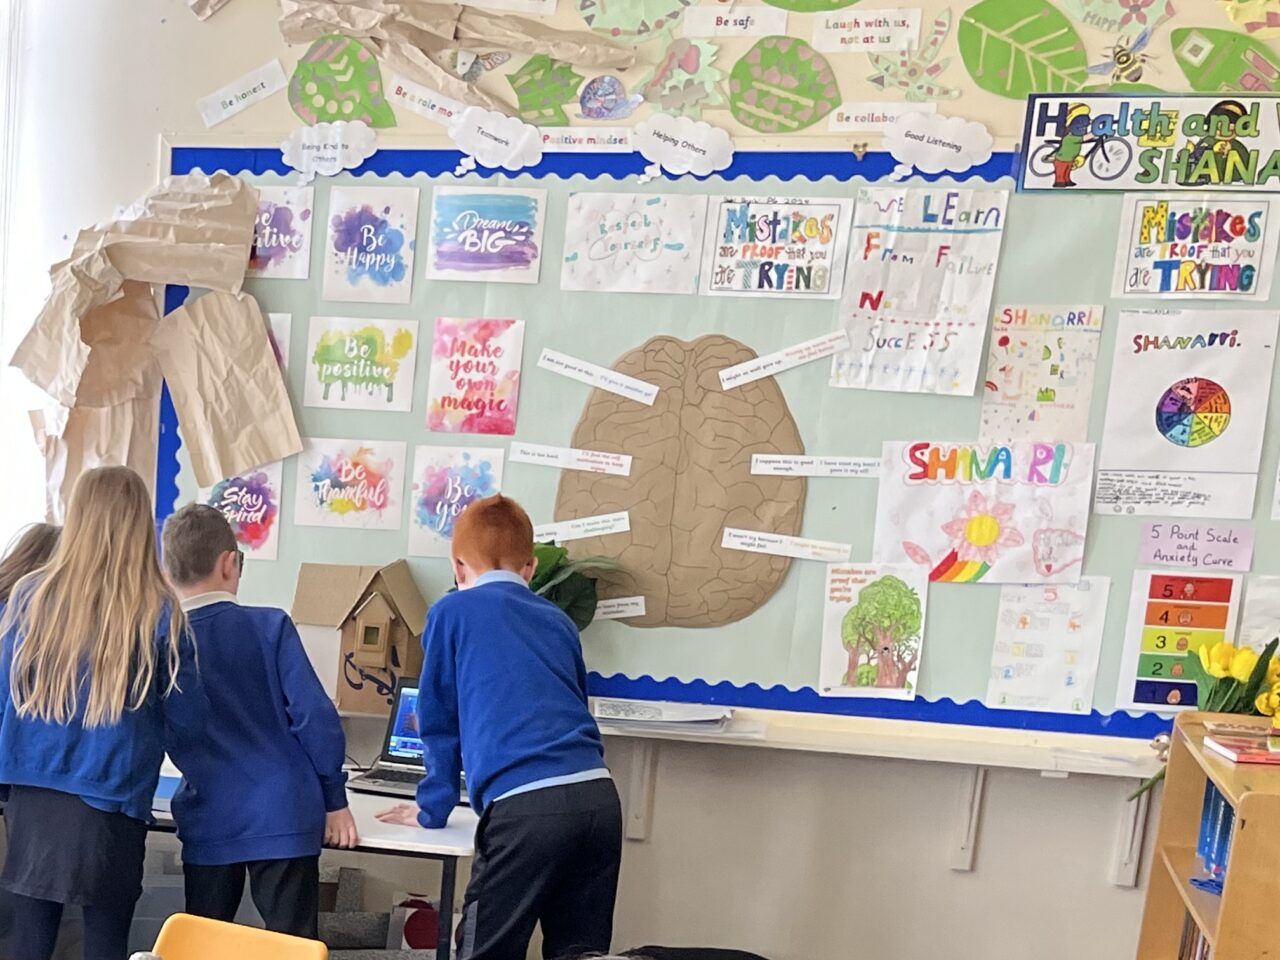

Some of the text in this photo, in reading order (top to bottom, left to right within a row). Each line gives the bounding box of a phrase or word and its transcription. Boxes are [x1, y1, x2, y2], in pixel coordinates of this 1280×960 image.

[715, 15, 755, 29] Be safe
[825, 18, 910, 32] Laugh with us,
[840, 35, 891, 45] not at us
[221, 81, 267, 110] Be honest
[395, 85, 407, 98] Be
[418, 97, 437, 110] role
[836, 112, 851, 123] Be
[1036, 101, 1173, 138] Health
[1182, 102, 1260, 138] and
[476, 126, 511, 147] Teamwork
[542, 134, 629, 145] Positive mindset
[652, 129, 708, 156] Helping Others
[904, 130, 962, 152] Good Listening
[455, 210, 514, 230] Dream
[723, 202, 834, 245] Mistakes
[1139, 200, 1263, 245] Mistakes
[360, 224, 385, 251] Be
[458, 231, 517, 253] BIG
[347, 247, 396, 272] Happy
[742, 243, 785, 259] PROOF
[1134, 243, 1256, 263] are PROOF that you
[736, 260, 829, 290] TRYING
[1129, 258, 1256, 291] are TRYING
[343, 336, 371, 358] Be
[449, 337, 504, 358] Make
[321, 359, 392, 380] positive
[449, 359, 499, 380] your
[456, 378, 497, 391] own
[440, 394, 508, 418] magic
[340, 459, 365, 482] Be
[221, 486, 263, 511] Stay
[318, 480, 387, 508] Thankful
[445, 476, 473, 503] Be
[436, 501, 468, 531] yo
[1151, 524, 1240, 544] 5 Point Scale
[1176, 541, 1197, 551] and
[1153, 549, 1234, 567] Anxiety Curve
[1044, 587, 1058, 602] 5
[1162, 584, 1173, 598] 5
[1159, 610, 1169, 624] 4
[1155, 635, 1166, 649] 3
[1151, 662, 1163, 676] 2
